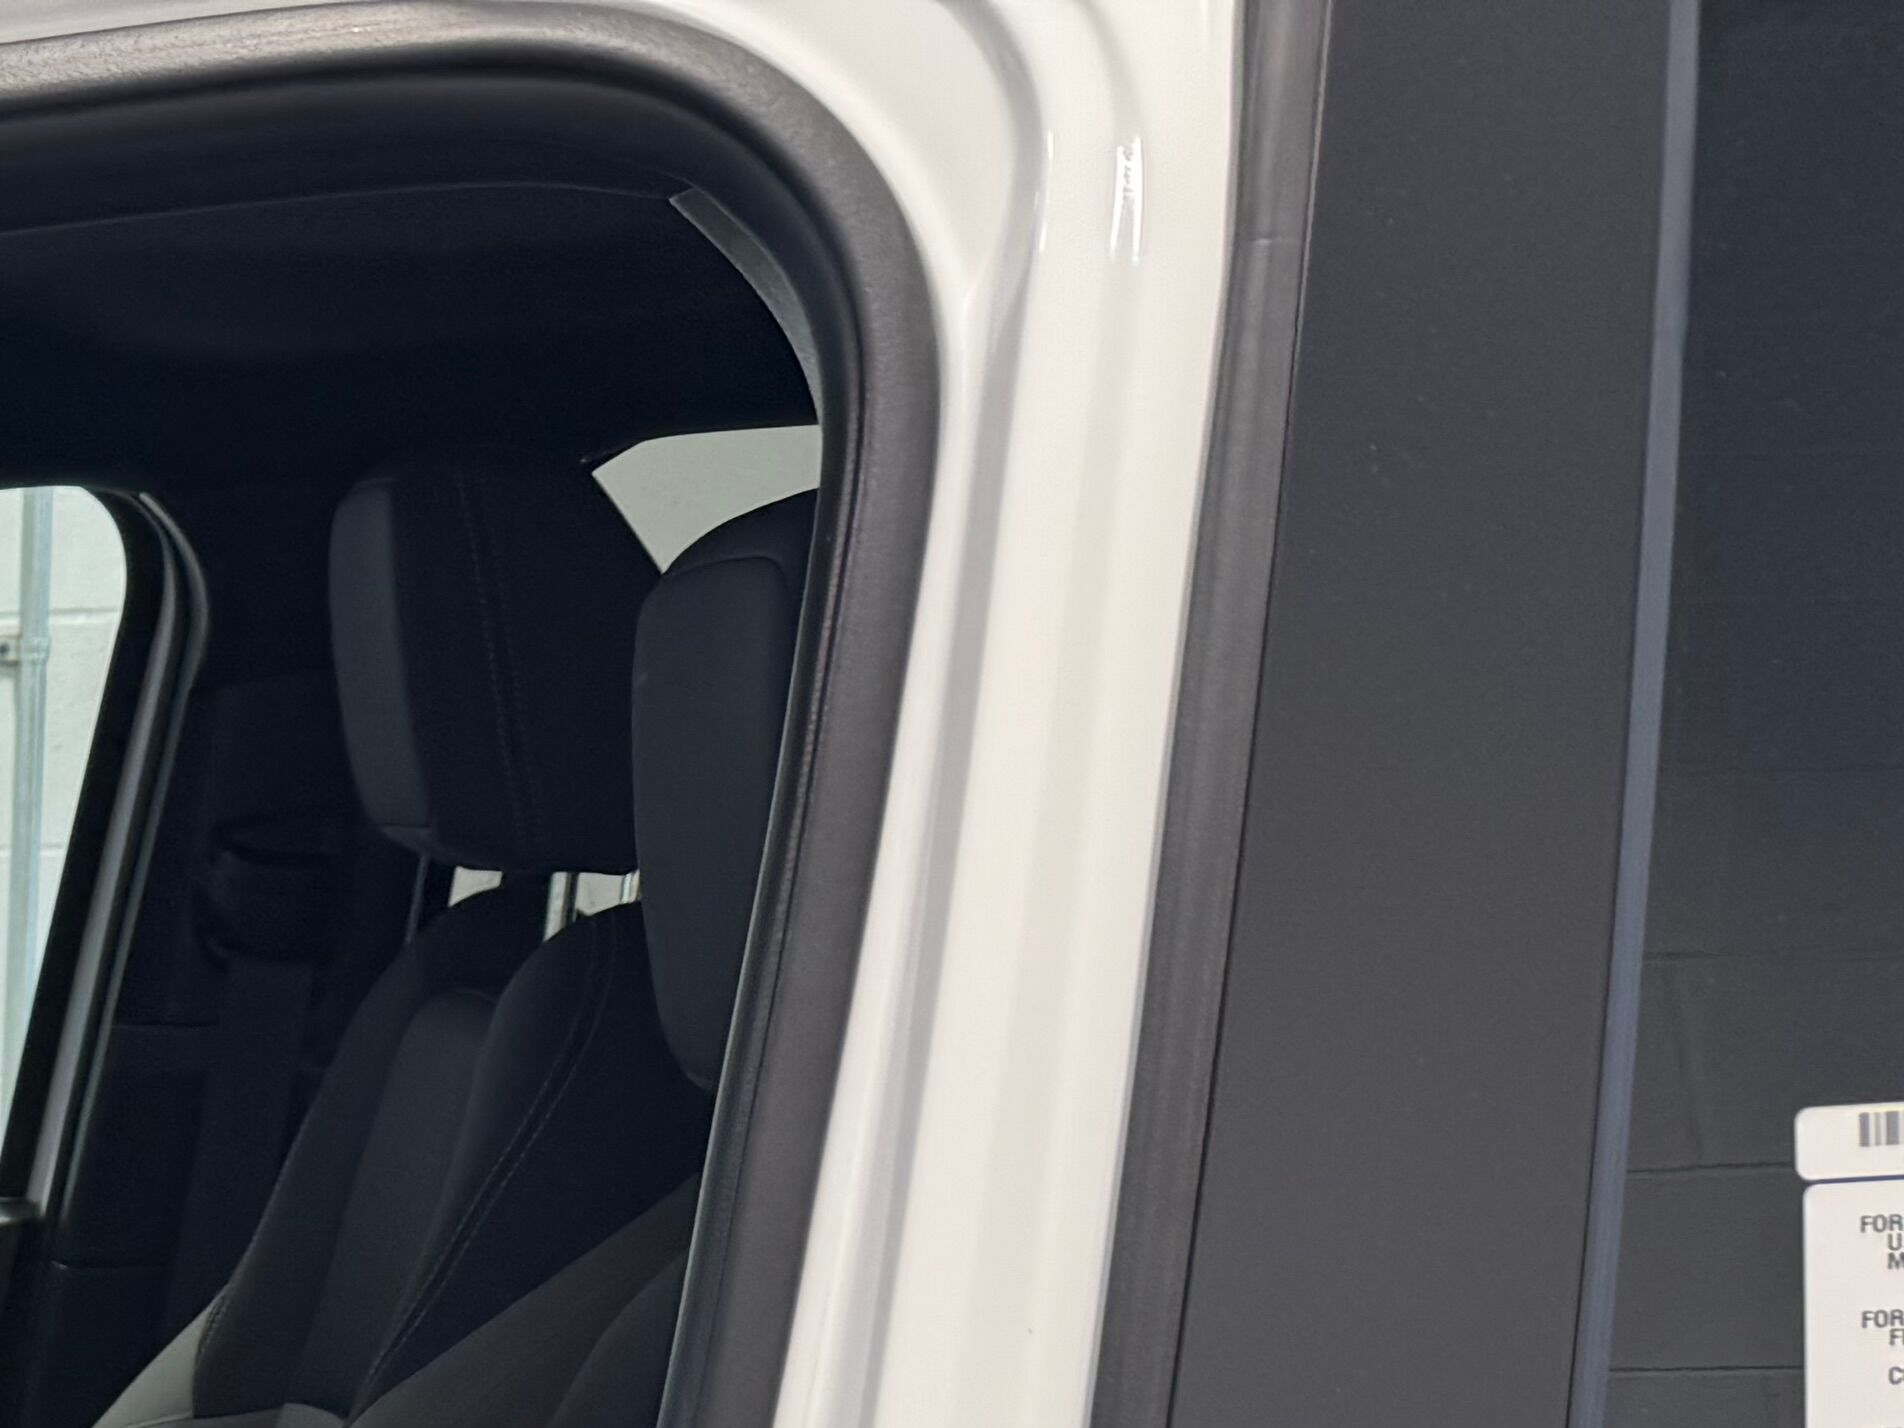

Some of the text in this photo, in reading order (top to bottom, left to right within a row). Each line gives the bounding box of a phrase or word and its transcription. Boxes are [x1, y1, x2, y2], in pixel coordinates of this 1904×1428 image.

[1860, 1213, 1904, 1233] FOR
[1887, 1232, 1904, 1251] U
[1861, 1309, 1904, 1329] FOR
[1888, 1365, 1904, 1386] C
